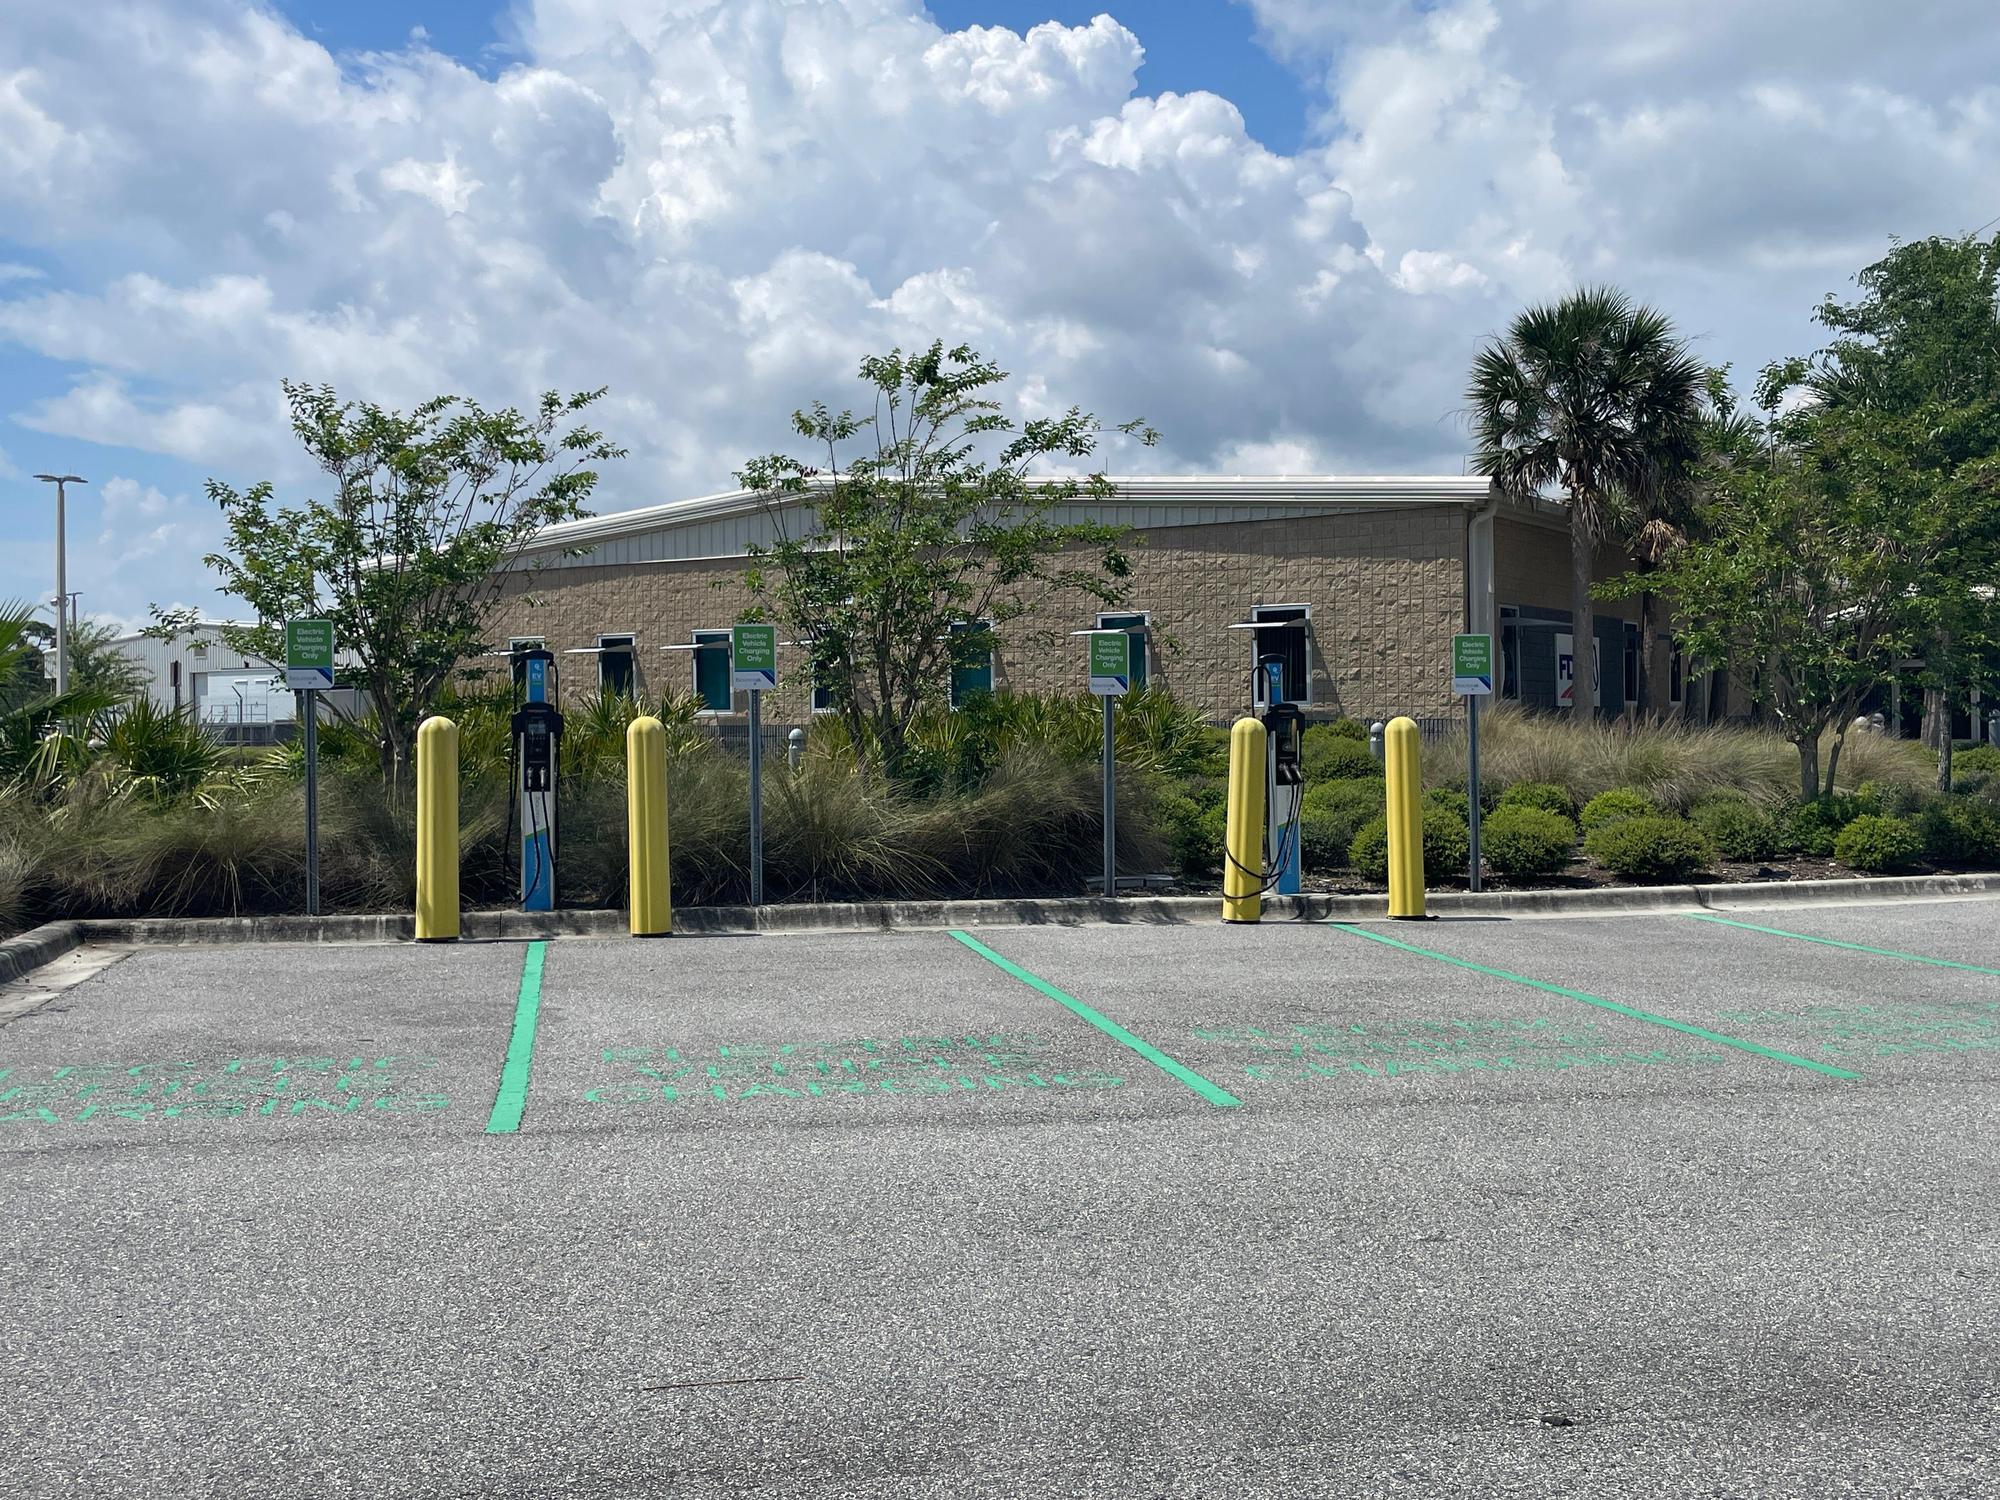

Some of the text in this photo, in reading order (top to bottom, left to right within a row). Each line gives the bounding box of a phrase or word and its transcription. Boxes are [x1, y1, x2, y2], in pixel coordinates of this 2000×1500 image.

[292, 644, 327, 652] Charging
[746, 655, 762, 663] Only
[1459, 655, 1487, 663] Charging
